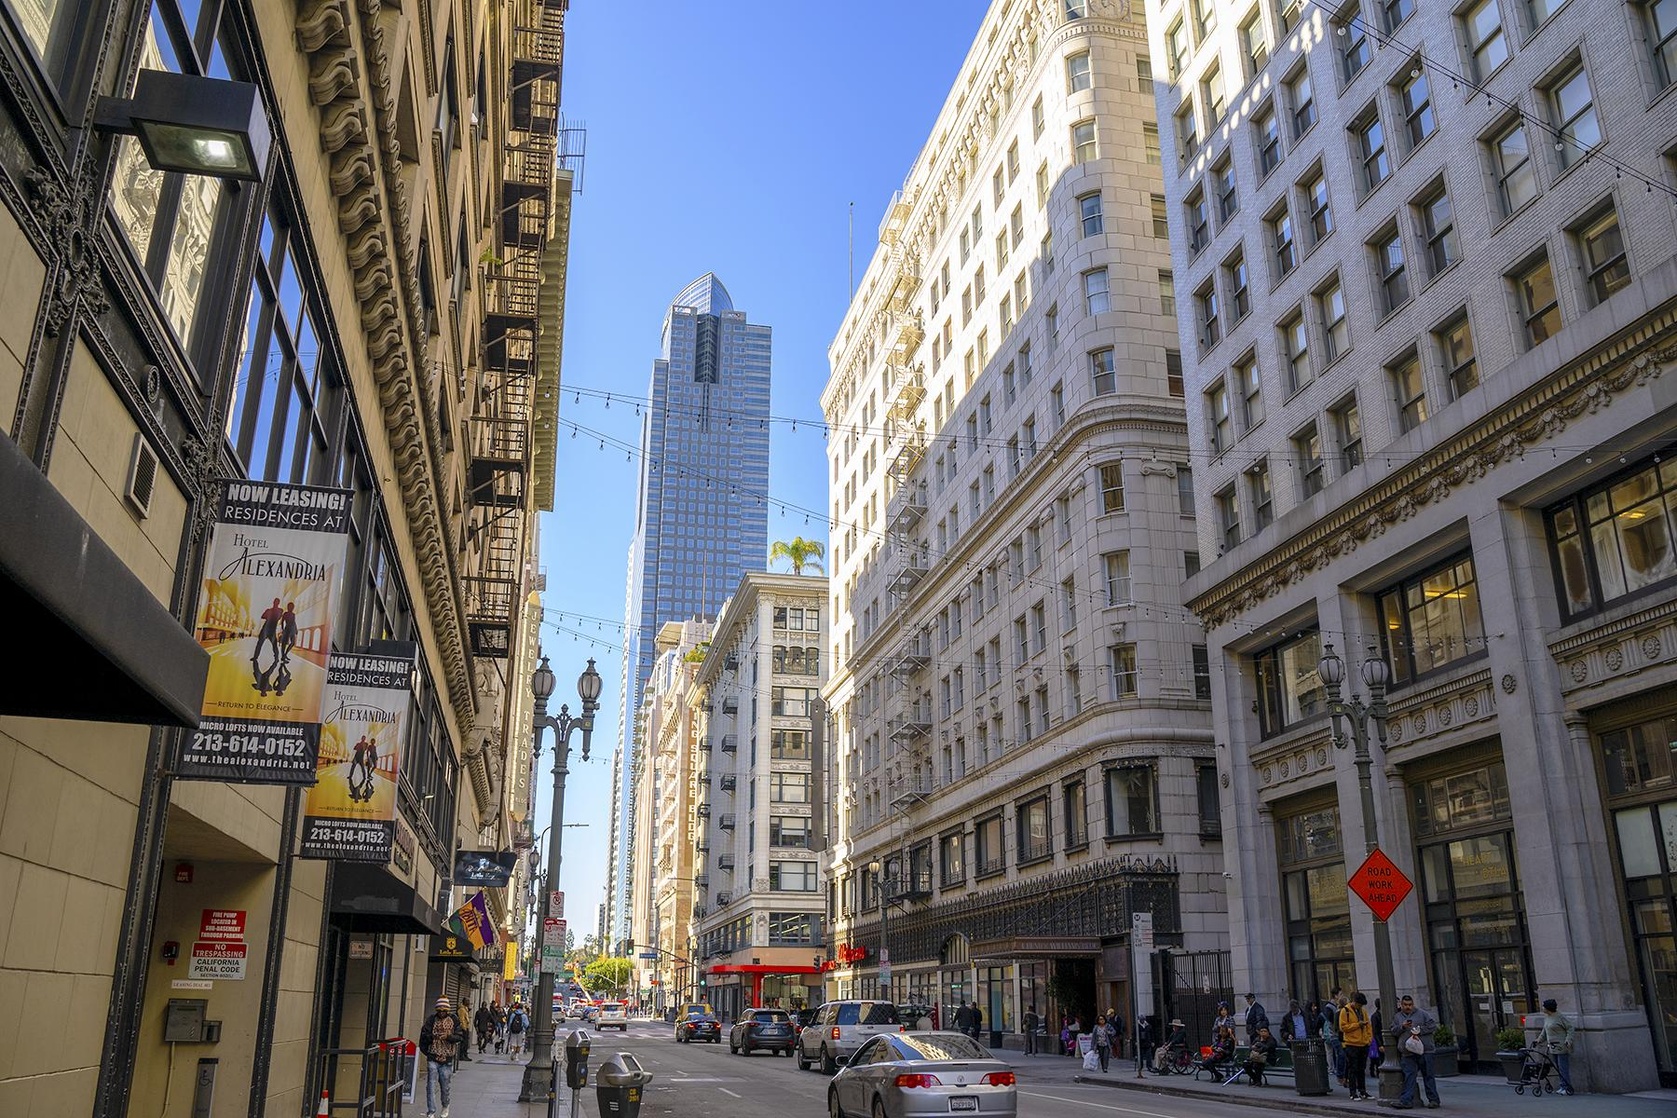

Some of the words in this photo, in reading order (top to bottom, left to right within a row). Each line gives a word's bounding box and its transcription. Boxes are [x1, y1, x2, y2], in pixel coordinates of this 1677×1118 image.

[227, 483, 269, 504] NOW
[271, 487, 347, 511] LEASING!
[224, 505, 319, 527] RESIDENCES
[323, 515, 344, 528] AT
[525, 611, 537, 698] JEWELRY
[329, 656, 358, 670] NOW
[358, 658, 409, 674] LEASING!
[327, 671, 391, 686] RESIDENCES
[393, 677, 407, 687] AT
[217, 700, 244, 709] RETURN
[245, 702, 255, 710] TO
[256, 702, 292, 712] ELEGANCE
[199, 721, 225, 731] MICRO
[225, 723, 247, 732] LOFTS
[247, 724, 266, 733] NOW
[266, 726, 304, 736] AVAILABLE
[192, 732, 306, 757] 213-614-0152
[519, 710, 530, 788] TRADES
[183, 753, 310, 769] www.thealexandria.net
[310, 827, 385, 844] 213-614-0152
[1367, 867, 1392, 877] ROAD
[1368, 879, 1393, 890] WORK
[1368, 892, 1397, 904] AHEAD
[195, 950, 244, 958] TRESPASSING
[214, 943, 227, 951] NO
[194, 965, 218, 973] PENAL
[196, 958, 240, 966] CALIFORNIA
